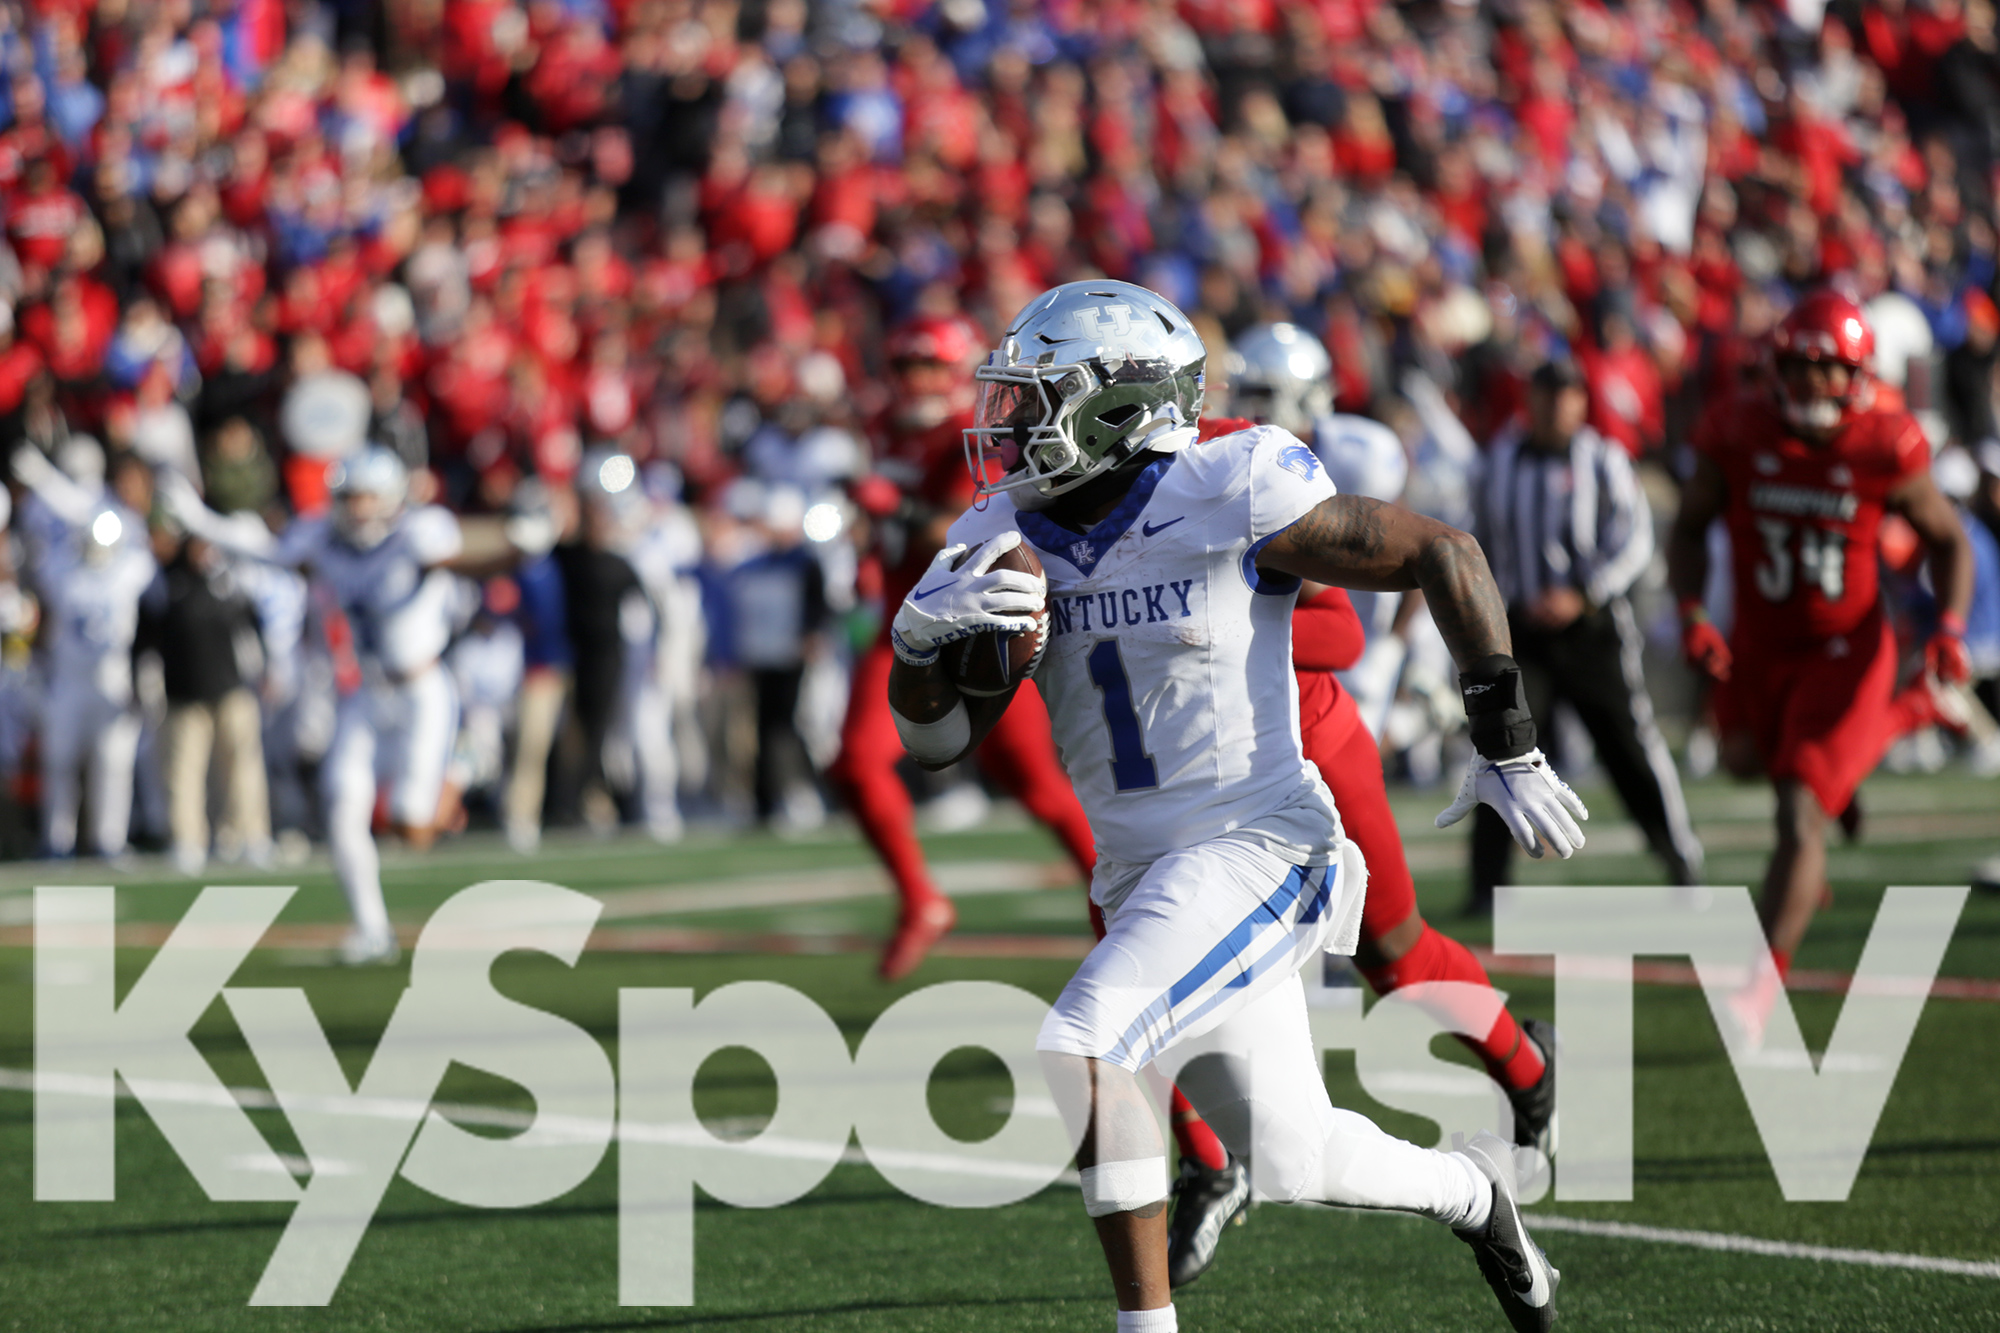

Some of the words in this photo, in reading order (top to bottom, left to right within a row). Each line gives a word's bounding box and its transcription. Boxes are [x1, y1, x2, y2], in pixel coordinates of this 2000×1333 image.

[1073, 304, 1155, 363] UK
[1070, 540, 1096, 566] UK
[1754, 516, 1847, 602] 34
[1050, 579, 1193, 636] NTUCKY
[1086, 637, 1159, 794] 1
